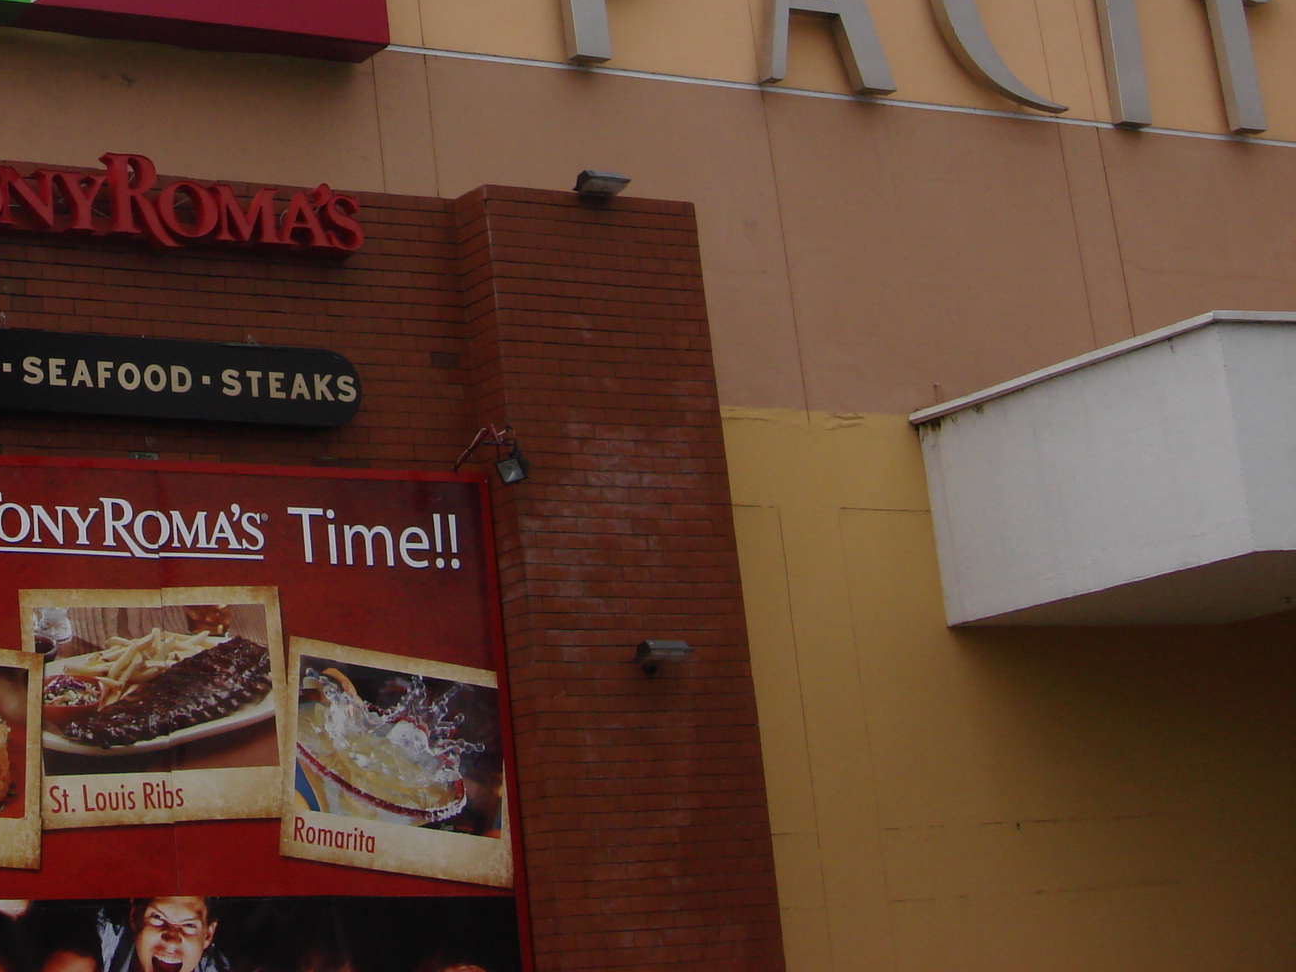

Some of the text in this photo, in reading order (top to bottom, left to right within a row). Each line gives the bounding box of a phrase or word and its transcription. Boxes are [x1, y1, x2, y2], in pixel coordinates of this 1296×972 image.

[22, 356, 193, 394] SEAFOOD
[222, 368, 357, 403] STEAKS
[287, 506, 461, 571] Time!!
[48, 780, 185, 814] St. Louis Ribs
[292, 818, 377, 855] Romarita
